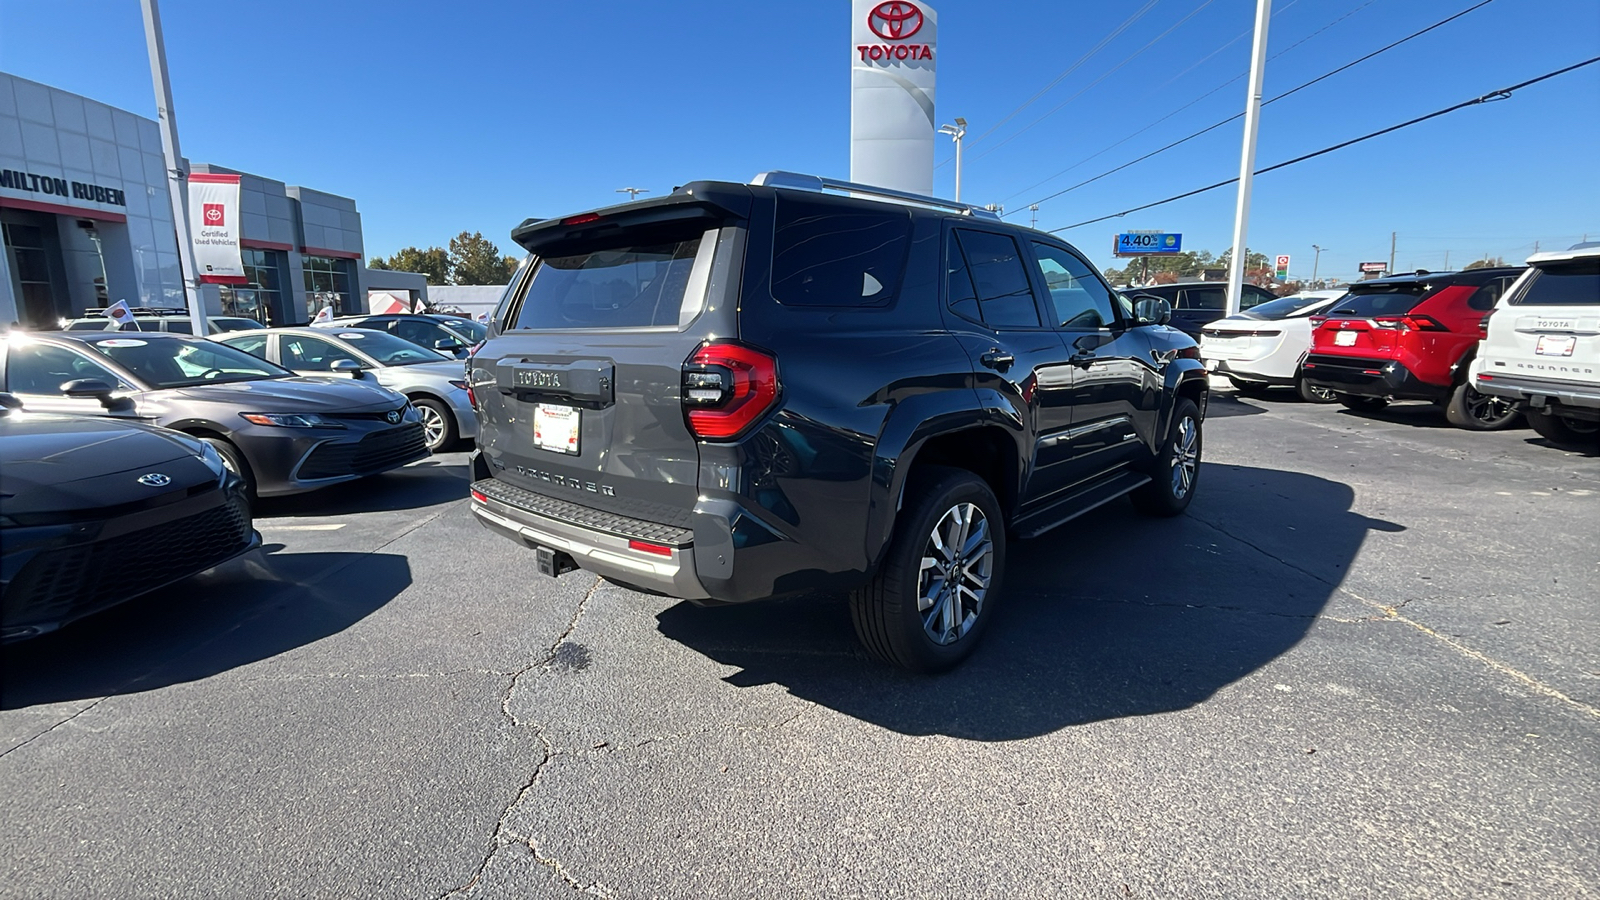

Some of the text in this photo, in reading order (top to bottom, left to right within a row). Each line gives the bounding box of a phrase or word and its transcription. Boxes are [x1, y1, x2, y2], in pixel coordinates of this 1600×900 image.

[857, 45, 932, 60] TOYOTA
[0, 169, 126, 206] MILTON RUBEN
[1517, 363, 1592, 373] 4RUNNER
[519, 371, 560, 387] TOYOTA
